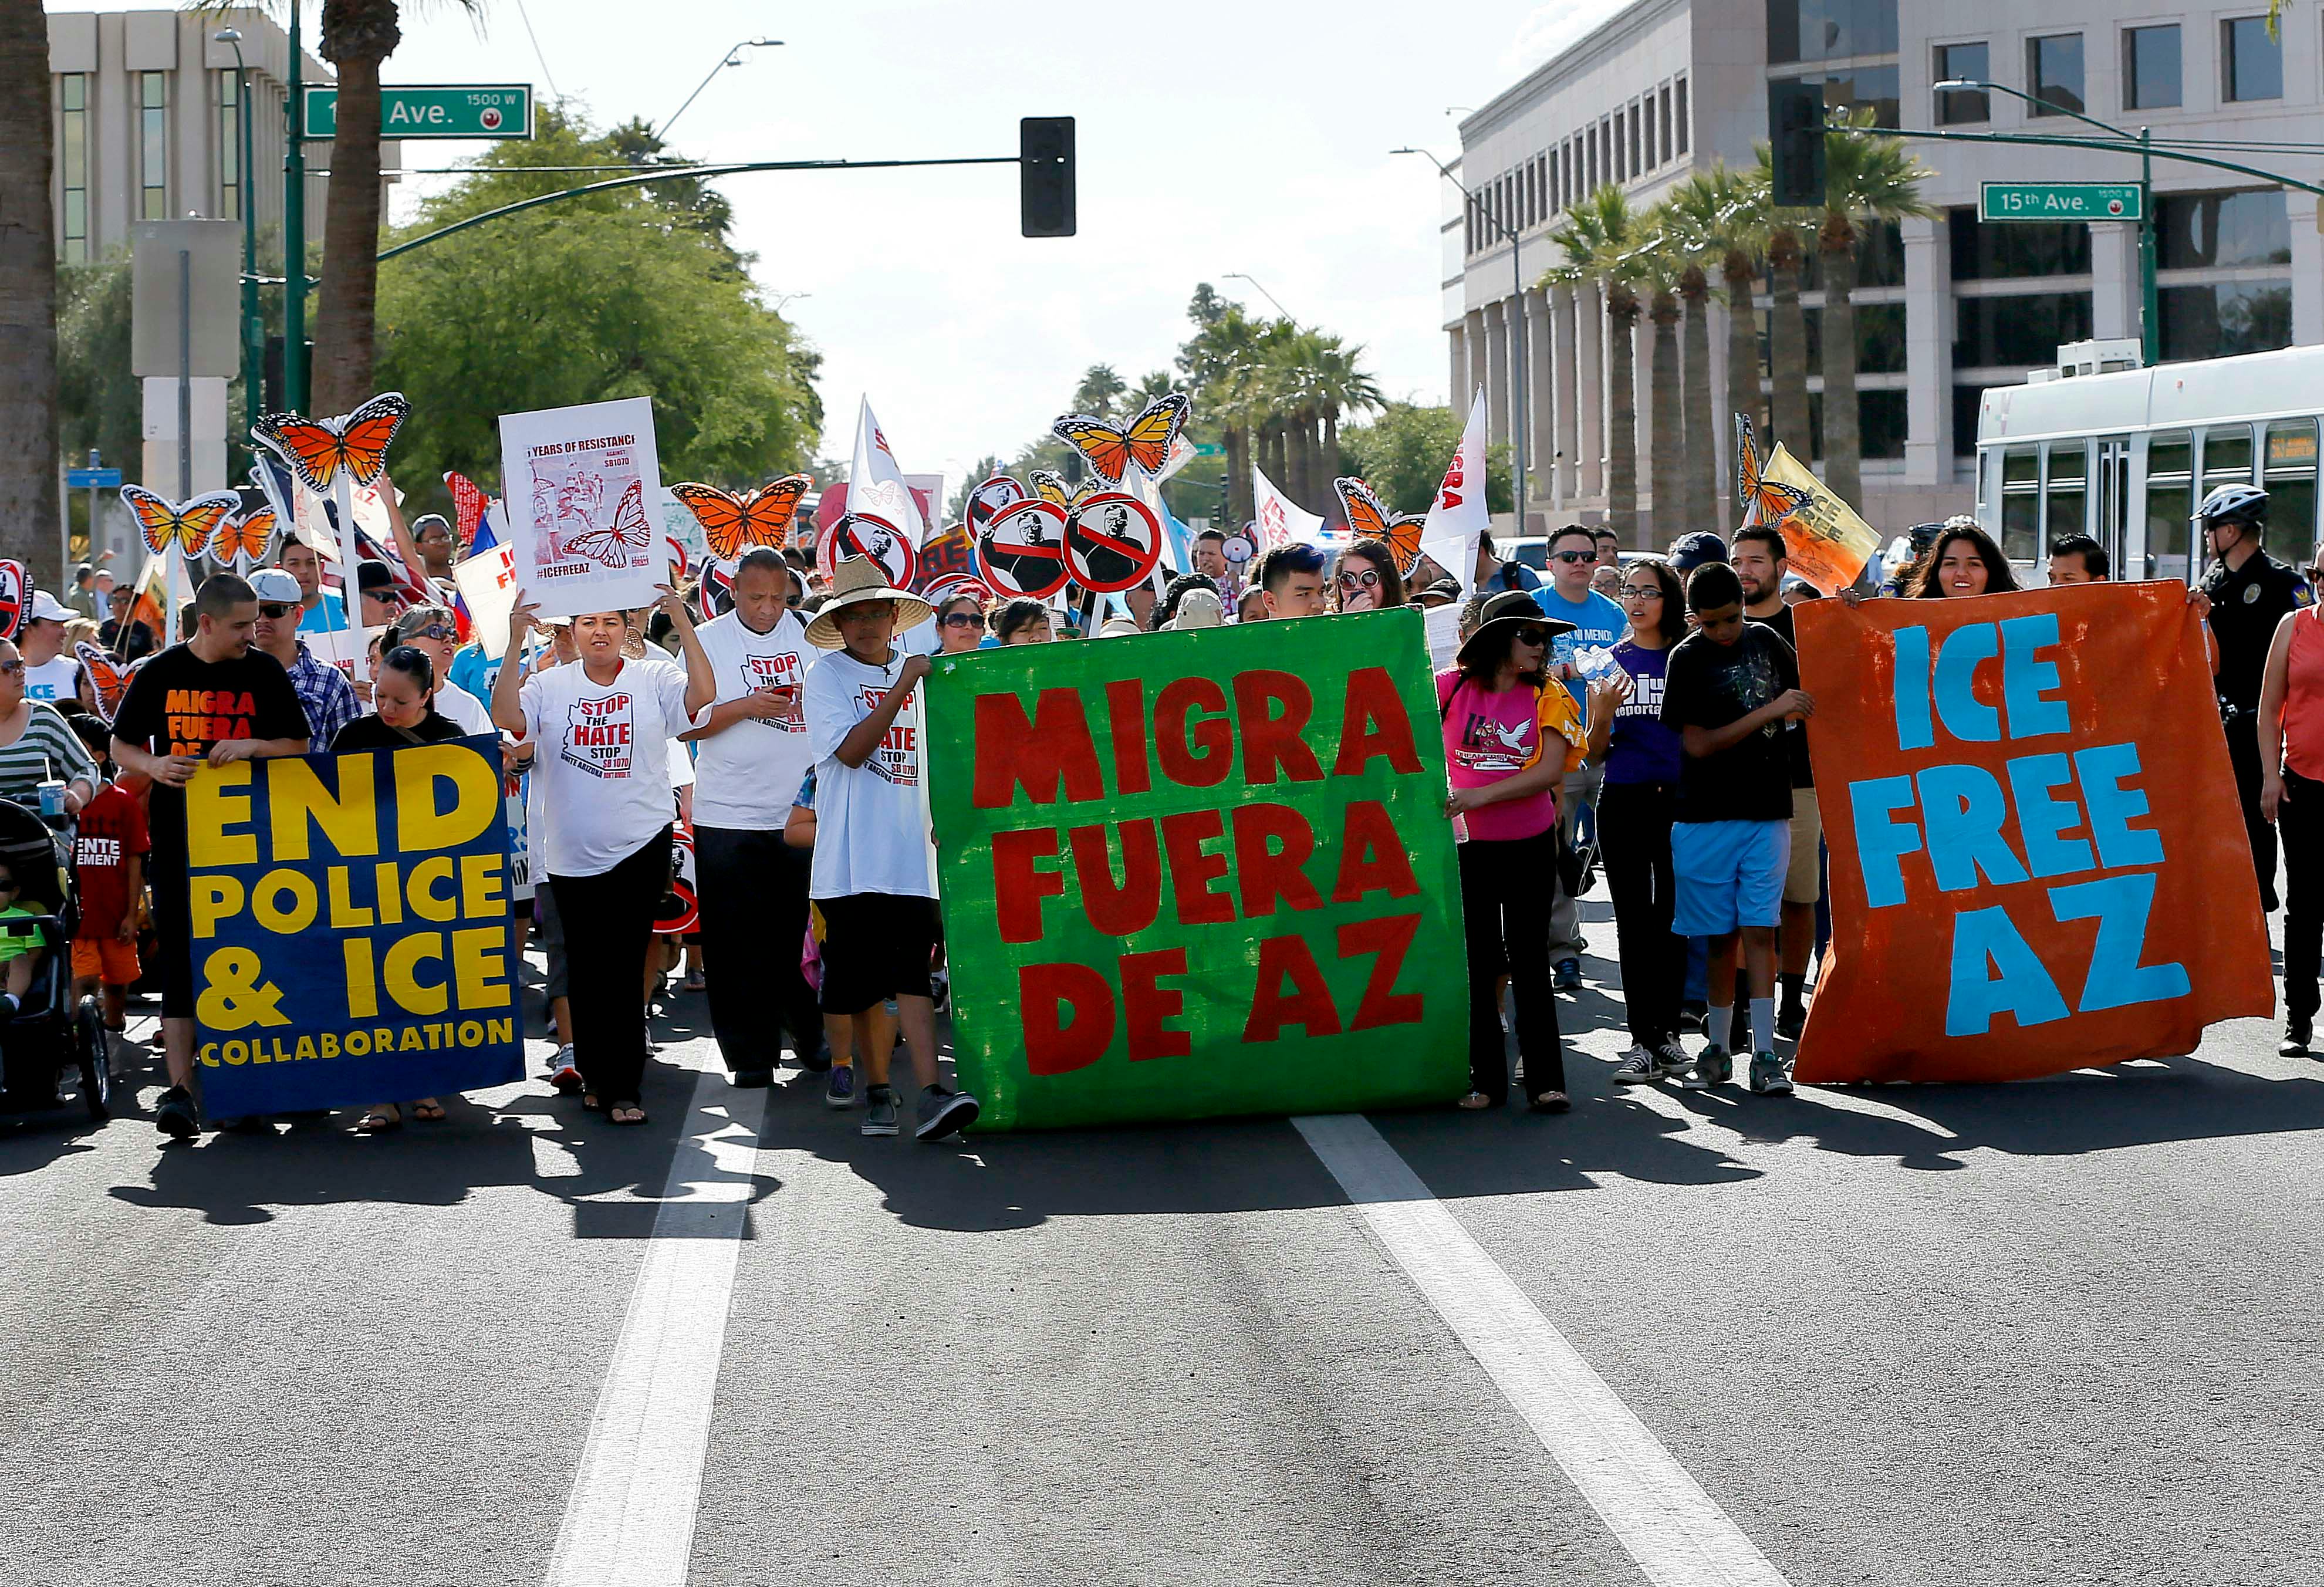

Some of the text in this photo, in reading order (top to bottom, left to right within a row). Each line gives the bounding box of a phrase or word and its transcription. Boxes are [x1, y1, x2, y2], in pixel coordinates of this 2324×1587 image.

[467, 94, 516, 106] 1500 W
[389, 100, 454, 124] Ave.
[2001, 193, 2089, 211] 15th Ave.
[532, 444, 563, 457] YEARS
[565, 442, 576, 453] OF
[604, 457, 630, 467] SB1070
[1795, 508, 1843, 543] REE
[536, 563, 590, 579] #ICEFREEAZ
[1584, 629, 1613, 642] MENOS
[751, 655, 797, 675] STOP
[759, 676, 782, 686] THE
[1893, 613, 2071, 751] ICE
[165, 690, 256, 716] MIGRA
[581, 695, 629, 716] STOP
[864, 690, 914, 711] STP
[168, 715, 252, 741] FUERA
[585, 715, 608, 726] THE
[762, 718, 789, 732] ARIZONA
[574, 722, 630, 746] HATE
[880, 727, 916, 751] ATE
[972, 667, 1426, 809] MIGRA
[590, 747, 621, 759] STOP
[603, 758, 629, 768] SB 1070
[881, 750, 906, 763] STOP
[560, 752, 603, 779] UNITE ARIZONA
[867, 763, 892, 783] ARIZONA
[891, 764, 901, 773] SB
[184, 744, 499, 869] END
[1849, 742, 2166, 909] FREE
[991, 801, 1421, 944] FUERA
[190, 853, 506, 938] POLICE
[1945, 873, 2191, 1036] AZ
[196, 927, 512, 1031] & ICE
[1019, 913, 1424, 1076] DE AZ
[200, 1017, 514, 1068] COLLABORATION
